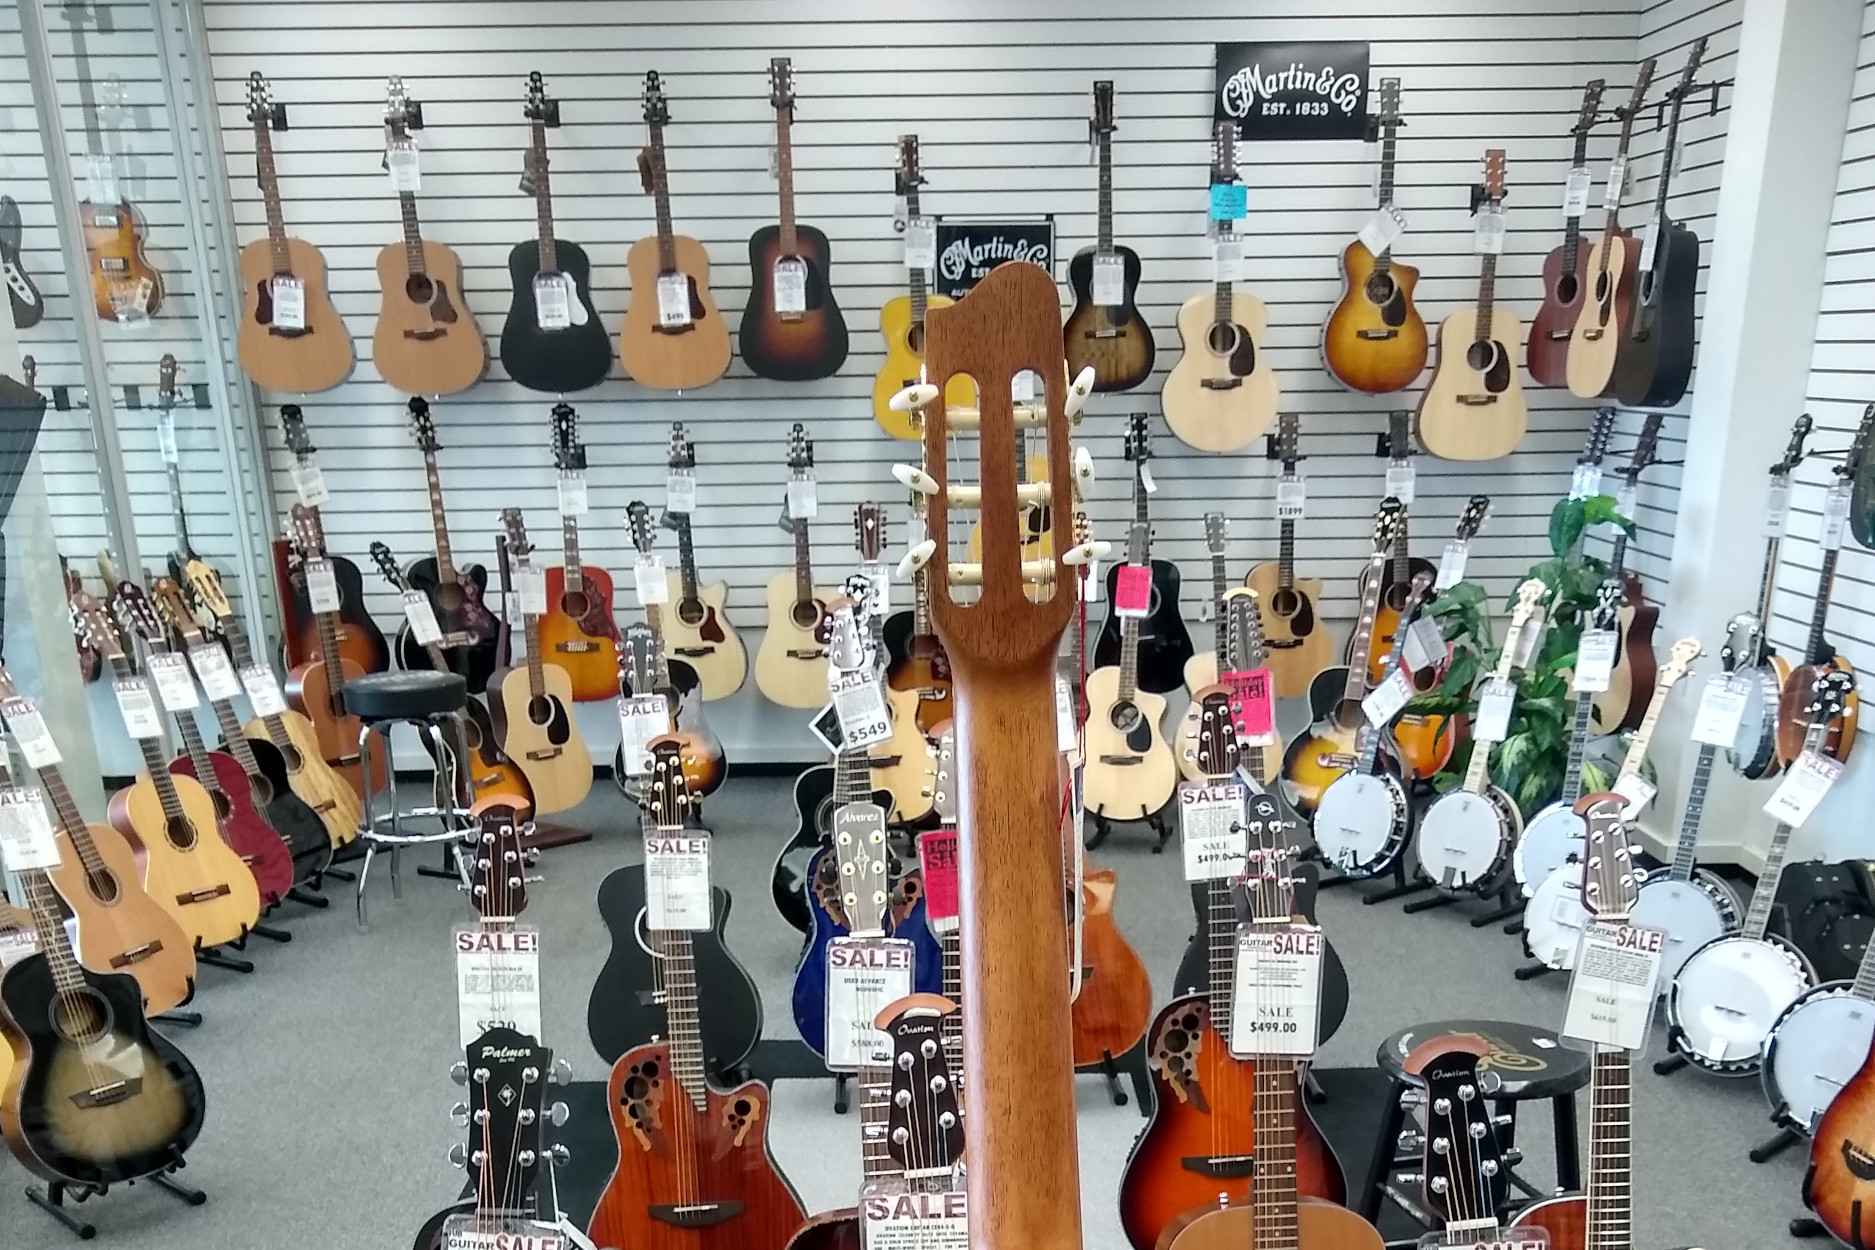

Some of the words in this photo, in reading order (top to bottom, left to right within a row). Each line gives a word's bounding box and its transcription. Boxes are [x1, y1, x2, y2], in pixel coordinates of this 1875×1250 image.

[1261, 102, 1291, 116] EST.
[1295, 102, 1329, 116] 1833
[621, 701, 666, 717] SALE!
[849, 721, 887, 743] $549
[0, 788, 41, 806] ALE!
[1183, 785, 1242, 804] SALE!
[840, 812, 879, 824] Alvarez
[648, 839, 706, 854] SALE!
[458, 933, 537, 952] SALE!
[1273, 934, 1320, 956] SALE!
[1616, 926, 1664, 953] SALE!
[832, 949, 911, 969] SALE!
[1259, 1007, 1294, 1018] SALE
[852, 1021, 874, 1031] SAL
[898, 1023, 934, 1035] Ovation
[1250, 1021, 1297, 1033] $499.00
[481, 1045, 531, 1059] Palmer
[1431, 1069, 1470, 1081] Ovation
[449, 1239, 494, 1250] GUITAR
